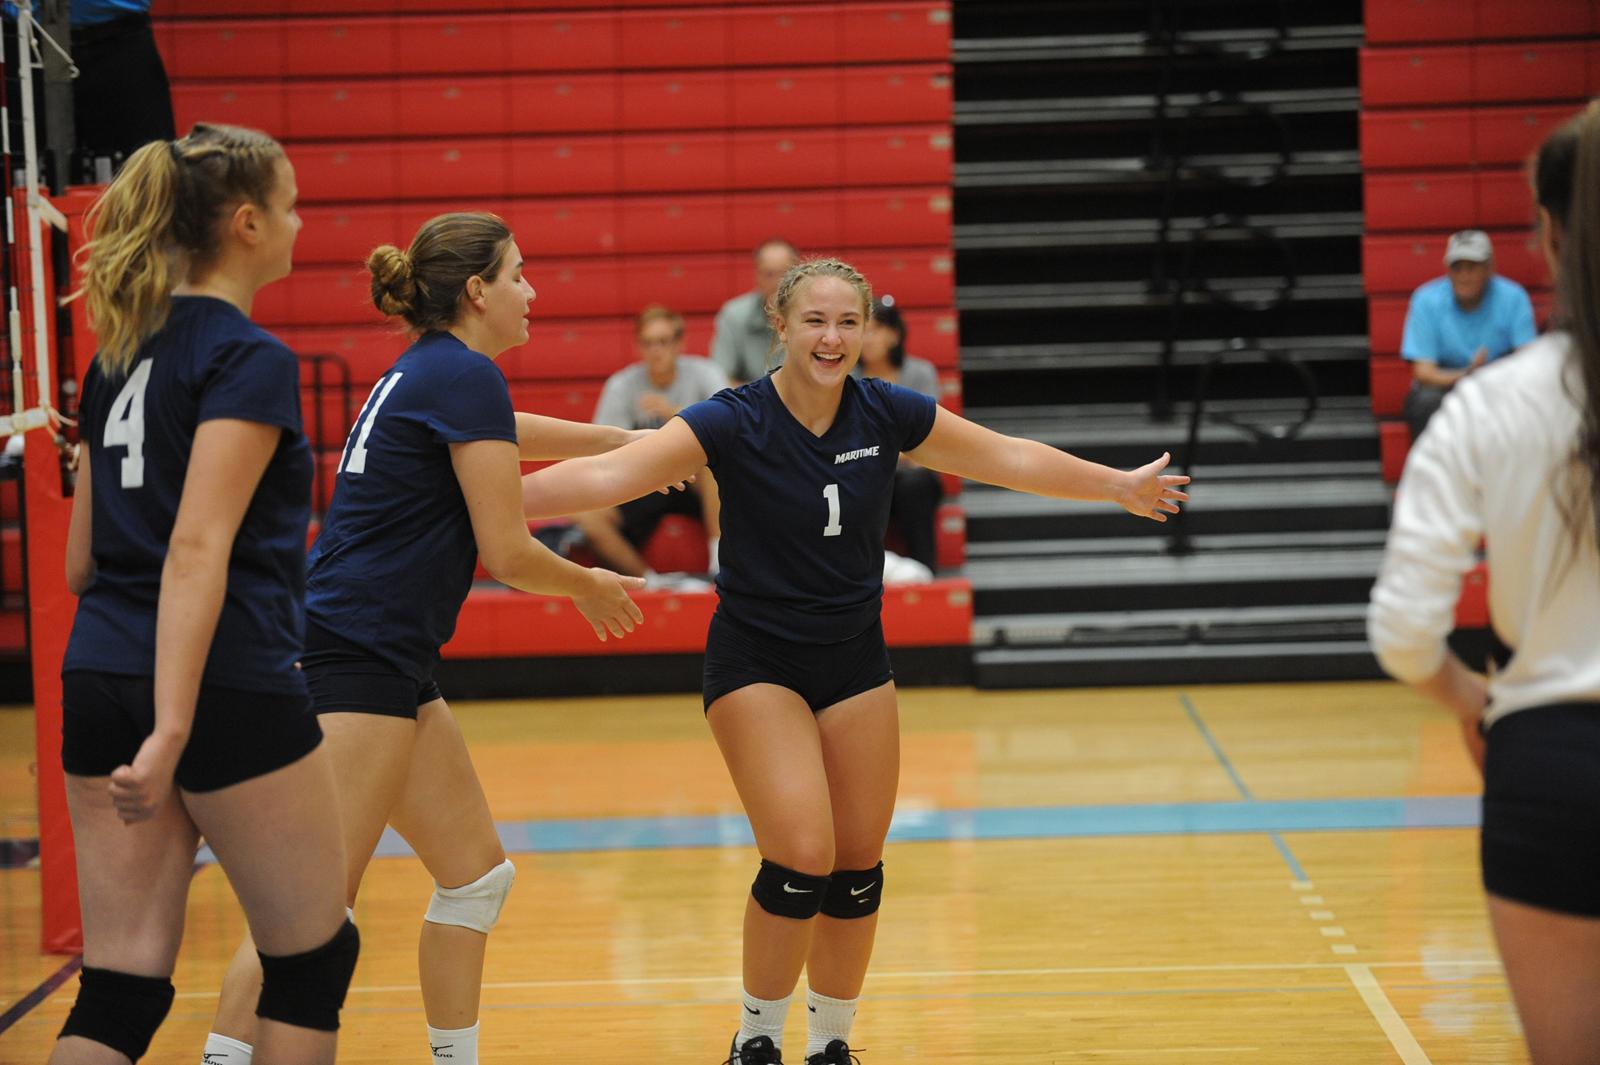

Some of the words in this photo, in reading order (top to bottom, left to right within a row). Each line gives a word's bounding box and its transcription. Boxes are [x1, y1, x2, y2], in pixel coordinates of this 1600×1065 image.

[103, 357, 154, 488] 4
[834, 445, 880, 464] MARITIME
[823, 483, 842, 536] 1
